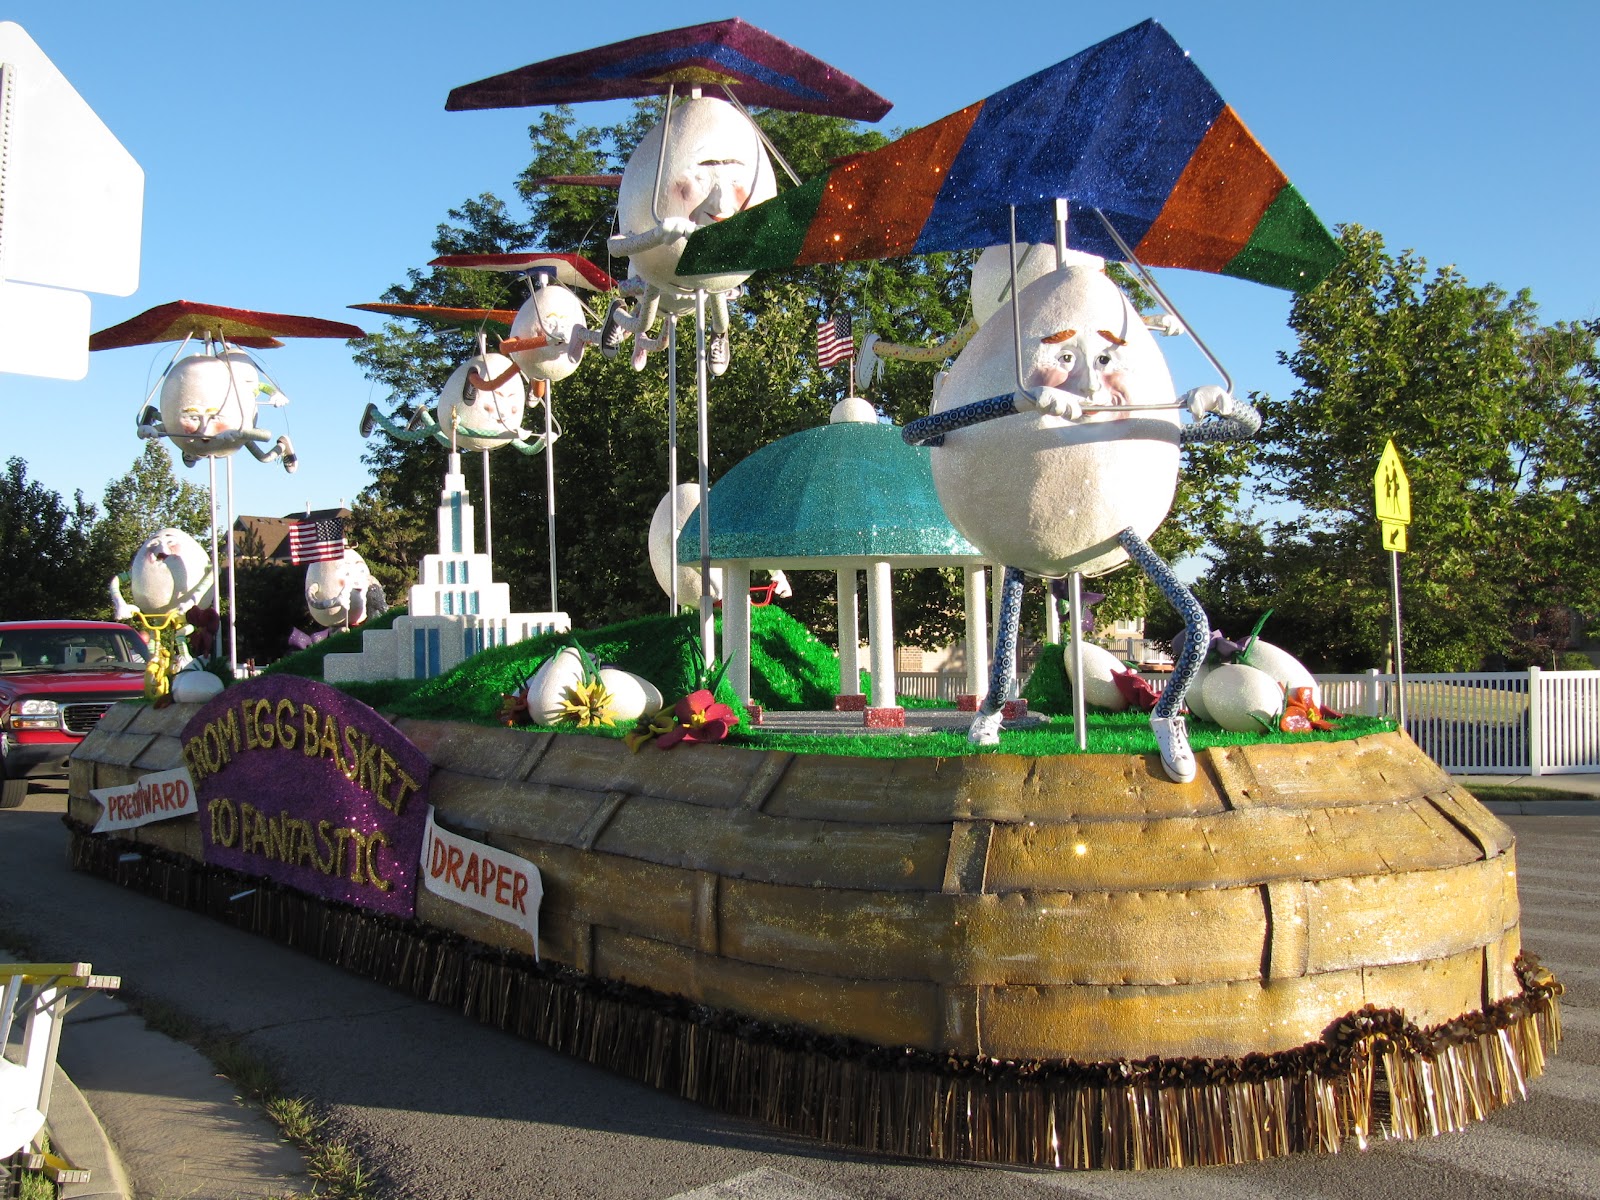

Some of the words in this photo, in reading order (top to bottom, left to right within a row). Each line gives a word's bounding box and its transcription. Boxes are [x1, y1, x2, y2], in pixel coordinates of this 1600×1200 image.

[183, 708, 240, 789] FROM
[241, 698, 299, 750] EGG
[303, 703, 422, 816] BASKET
[208, 799, 239, 847] TO
[240, 802, 393, 892] FANTASTIC
[430, 836, 528, 916] DRAPER
